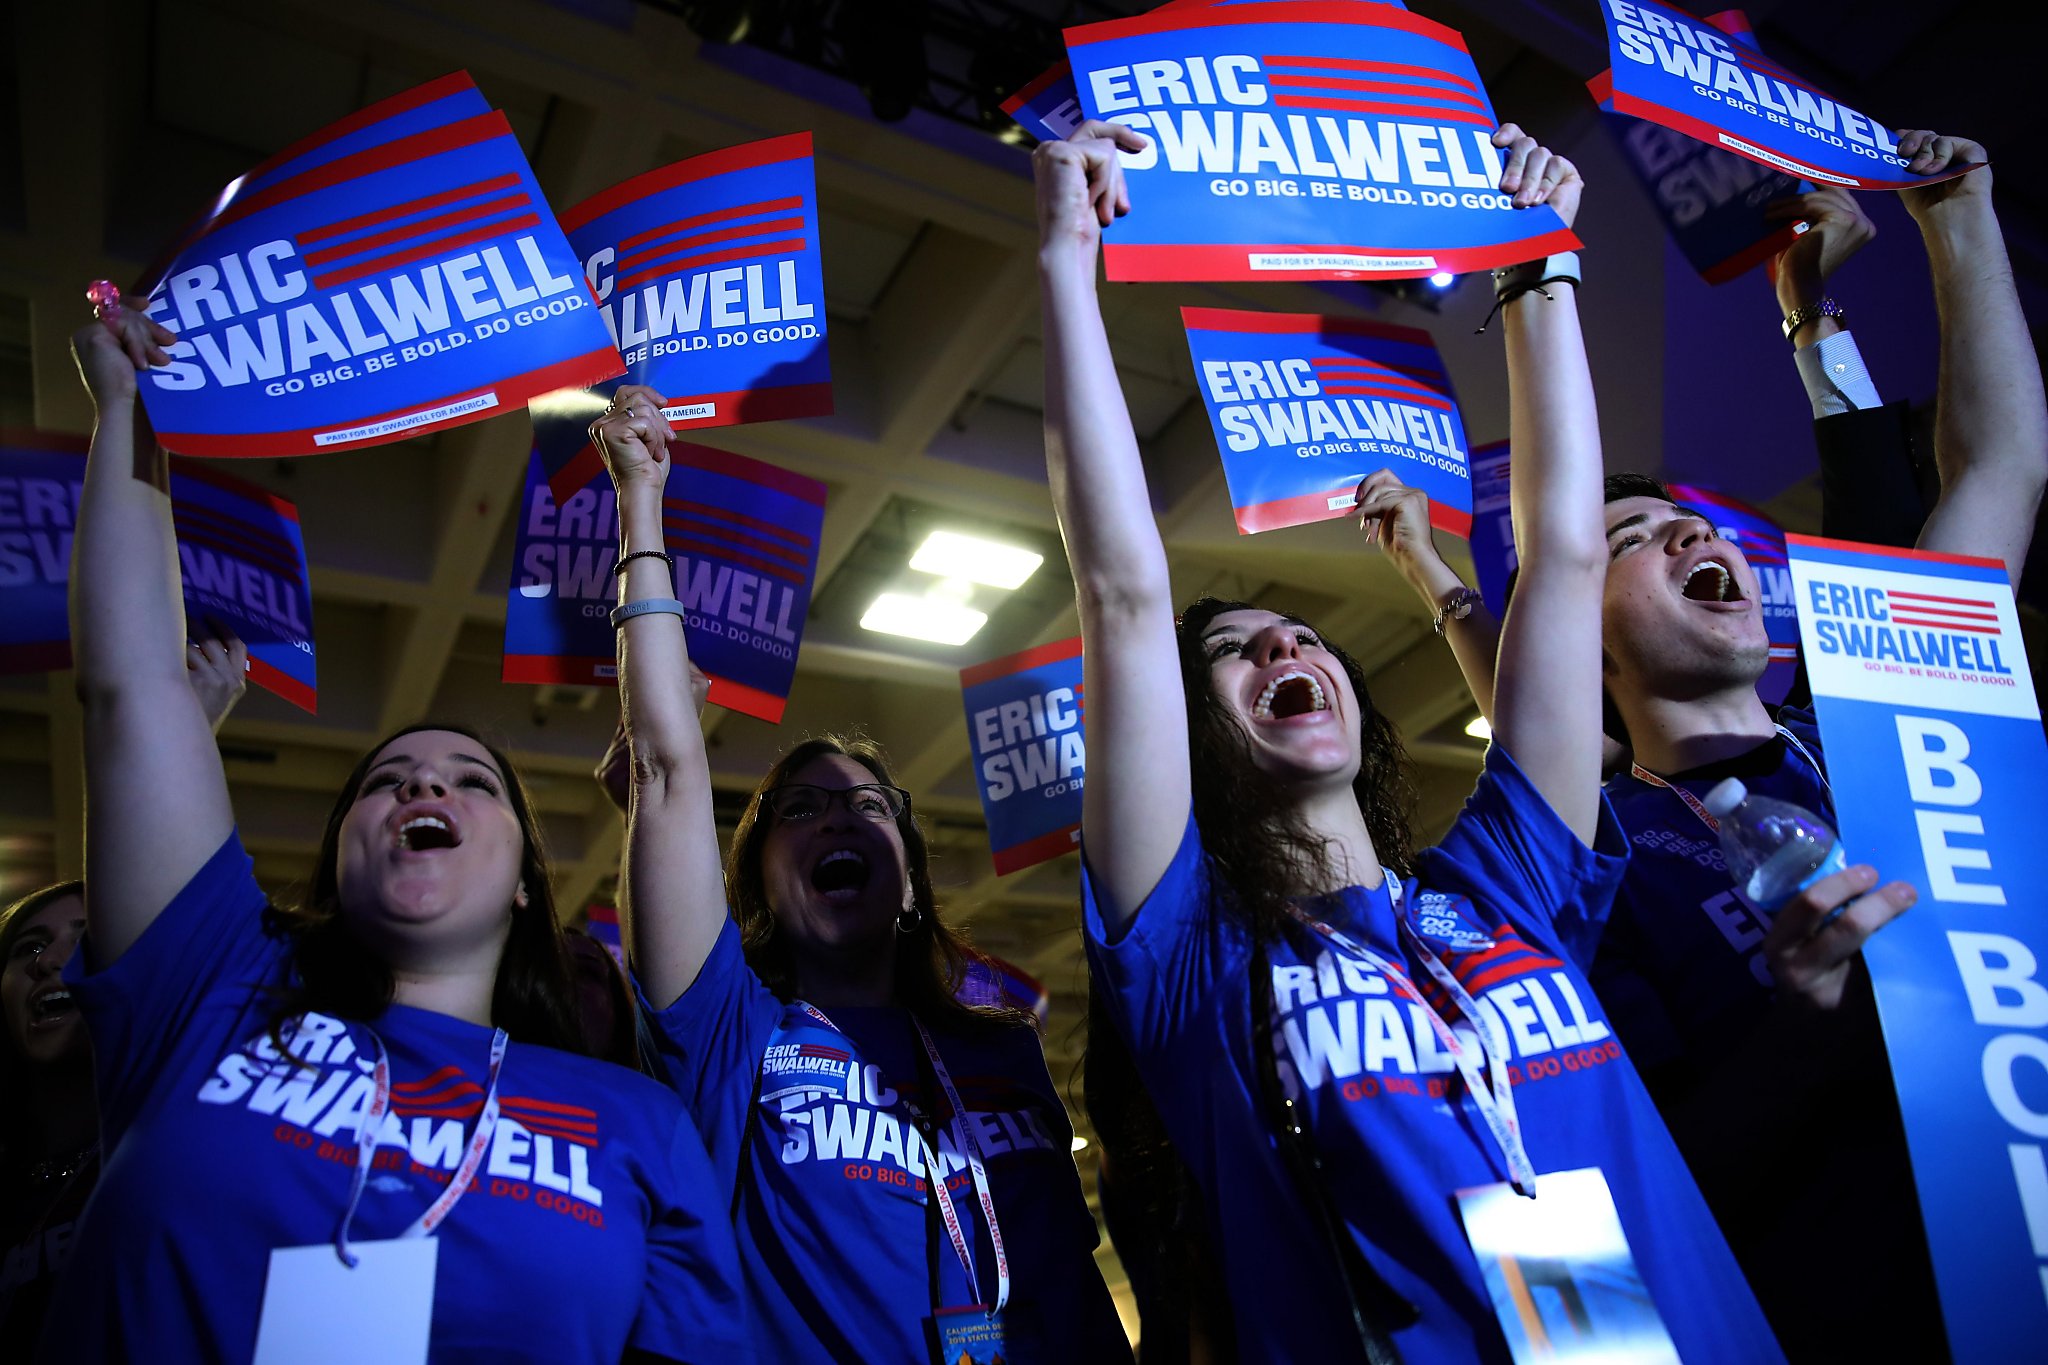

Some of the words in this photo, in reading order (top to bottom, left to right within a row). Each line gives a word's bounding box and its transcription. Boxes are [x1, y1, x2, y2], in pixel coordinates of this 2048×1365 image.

[1609, 0, 1736, 63] ERIC
[1088, 54, 1269, 114] ERIC
[1616, 23, 1901, 155] SWALWEL
[1693, 85, 1721, 101] GO
[1726, 96, 1763, 118] BIG.
[1766, 111, 1790, 128] BE
[1794, 122, 1847, 150] BOLD.
[1851, 143, 1878, 160] DO
[1882, 154, 1911, 168] GO
[1210, 179, 1249, 197] GO
[1255, 181, 1306, 198] BIG.
[1312, 183, 1343, 200] BE
[1347, 186, 1418, 206] BOLD.
[1422, 191, 1458, 208] DO
[1461, 193, 1516, 211] GOO
[143, 239, 308, 335] ERIC
[150, 235, 575, 393] SWALWELL
[265, 379, 304, 397] GO
[309, 365, 362, 388] BIG.
[364, 353, 398, 374] BE
[400, 332, 472, 363] BOLD.
[474, 318, 511, 340] DO
[514, 295, 589, 327] GOOD.
[625, 347, 648, 367] BE
[652, 336, 712, 356] BOLD.
[717, 332, 748, 348] DO
[752, 324, 821, 344] GOOD.
[1201, 358, 1320, 403] ERIC
[326, 433, 348, 443] PAID
[350, 429, 367, 438] FOR
[368, 425, 380, 435] BY
[382, 414, 431, 432] SWALWELL
[431, 409, 448, 419] FOR
[449, 399, 488, 416] AMERICA
[672, 406, 707, 418] AMERICA
[1219, 399, 1465, 464] SWALWELL
[1296, 445, 1321, 458] GO
[1324, 442, 1357, 454] BIG.
[1359, 442, 1379, 453] BE
[1381, 443, 1418, 461] BOLD.
[1419, 452, 1437, 466] DO
[1438, 458, 1469, 480] GOOD.
[527, 484, 620, 541] ERI
[519, 542, 796, 645] SWWELL
[1808, 580, 1889, 622] ERIC
[582, 603, 606, 619] GO
[727, 625, 749, 645] DO
[1815, 619, 2012, 675] SWALWELL
[1864, 661, 1881, 672] GO
[1909, 668, 1924, 677] BE
[1962, 673, 1979, 683] DO
[974, 687, 1078, 755] ERIC
[1045, 783, 1066, 799] GO
[1895, 714, 2007, 906] BE
[1694, 848, 1724, 866] DO
[1421, 917, 1456, 930] DO
[1273, 949, 1389, 1015] RIC
[763, 1043, 801, 1059] ERIC
[1280, 970, 1611, 1091] WALWELL
[762, 1056, 847, 1076] SWALWELL
[1343, 1078, 1380, 1101] GO
[1526, 1060, 1561, 1082] DO
[274, 1123, 313, 1150] GO
[490, 1180, 529, 1201] DO
[844, 1163, 873, 1181] GO
[877, 1167, 911, 1188] BIG.
[935, 1183, 972, 1272] #SWALWELLING
[980, 1191, 1009, 1280] #SWALWELLING
